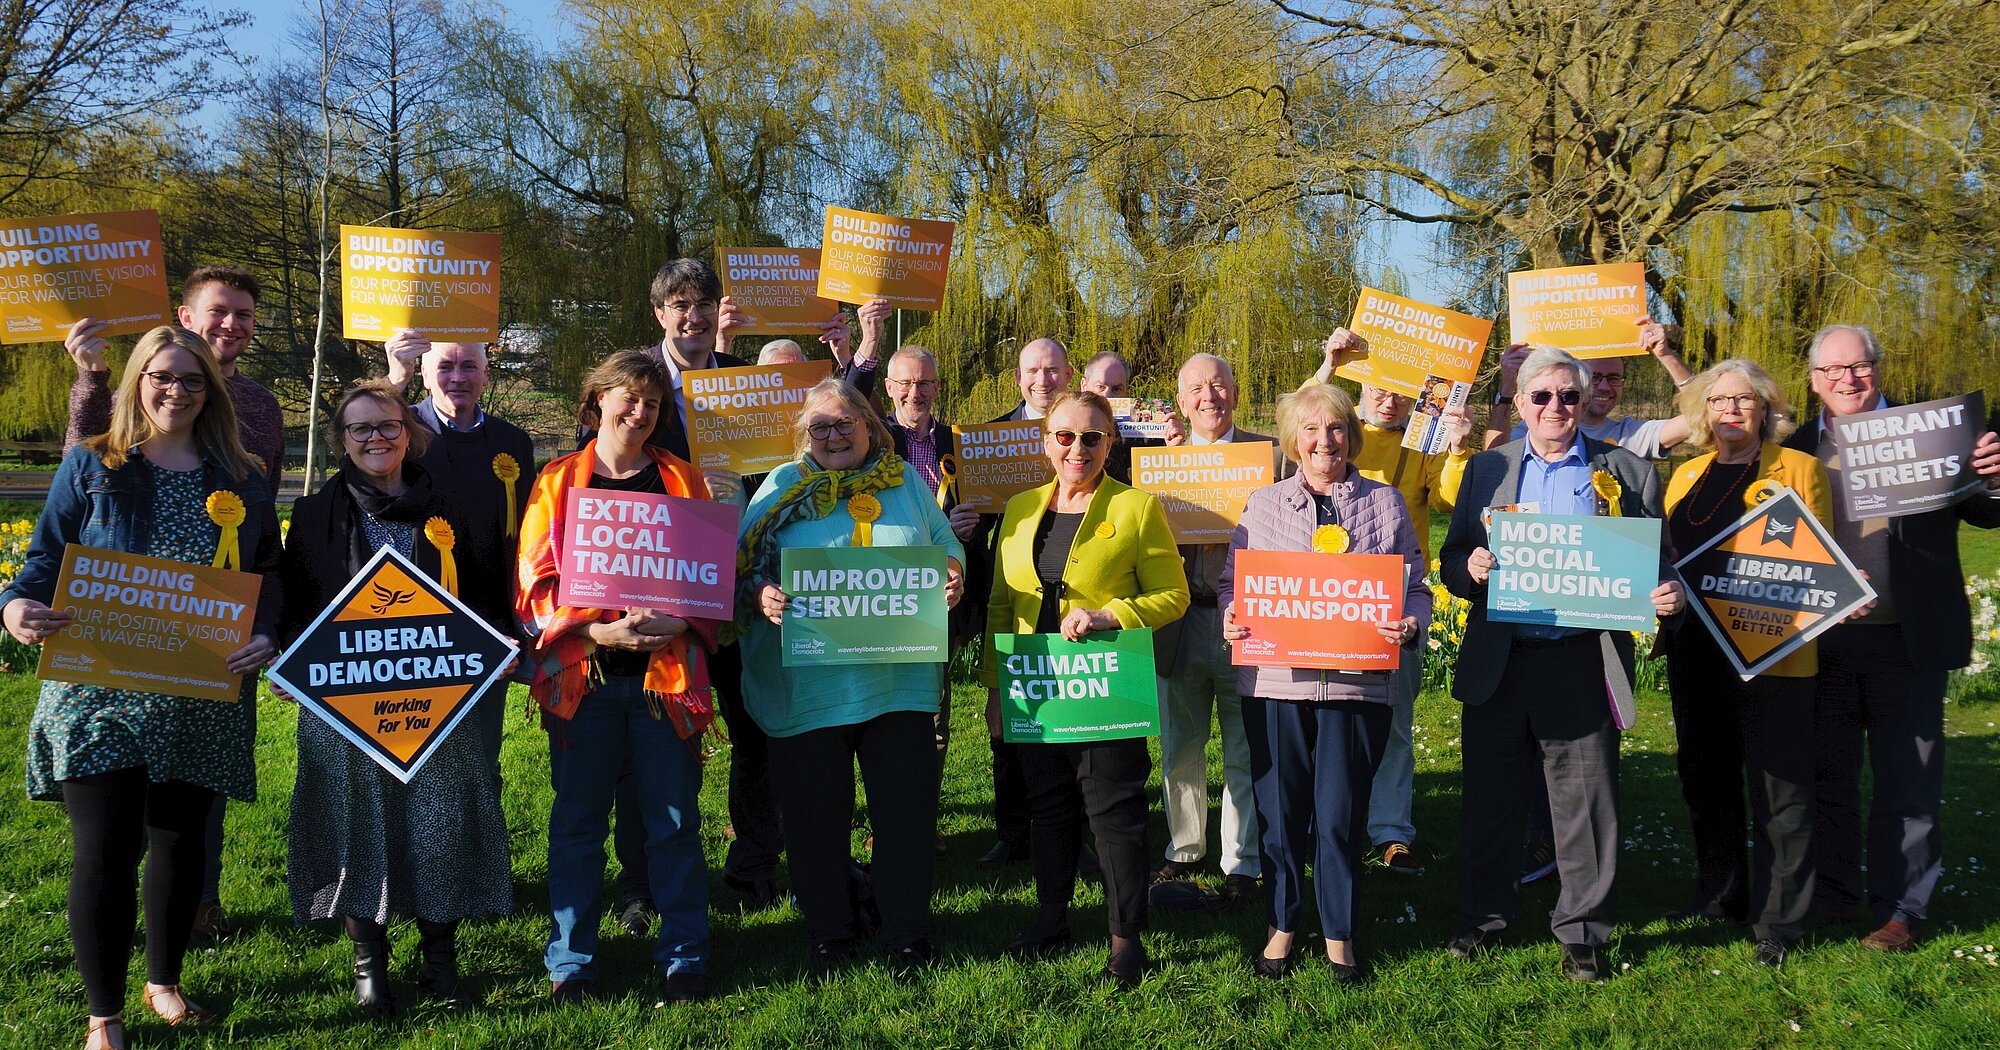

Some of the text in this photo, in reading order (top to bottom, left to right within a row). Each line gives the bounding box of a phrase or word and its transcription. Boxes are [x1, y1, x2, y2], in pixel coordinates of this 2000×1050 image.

[0, 224, 100, 246] UILDING
[832, 214, 911, 238] BUILDING
[350, 235, 445, 256] BUILDING
[831, 231, 944, 256] OPPORTUNITY
[350, 254, 491, 275] OPPORTUNITY
[728, 254, 800, 266] BUILDING
[828, 259, 908, 280] FOR WAVERLEY
[829, 248, 942, 271] OUR POSITIVE VISION
[34, 269, 102, 287] POSITIVE
[106, 264, 156, 280] VISION
[729, 268, 820, 280] OPPORTUNIT
[1516, 273, 1598, 292] BUILDING
[0, 284, 113, 304] FOR WAVERLEY
[351, 277, 491, 294] OUR POSITIVE VISION
[731, 286, 817, 296] OUR POSITIVE VIS
[1519, 285, 1638, 307] OPPORTUNITY
[351, 291, 449, 308] FOR WAVERLEY
[732, 297, 806, 306] FOR WAVERLEY
[1366, 296, 1446, 329] BUILDING
[1546, 307, 1597, 320] POSITIVE
[1600, 304, 1640, 316] VISION
[1362, 311, 1478, 354] OPPORTUNITY
[1544, 318, 1604, 332] WAVERLEY
[1357, 329, 1473, 370] OUR POSITIVE VISION
[1359, 342, 1436, 371] OR WAVERLEY
[692, 372, 784, 394] BUILDING
[694, 388, 814, 411] OPPORTUNIT
[696, 418, 725, 429] OUR
[728, 412, 787, 427] POSITIVE
[1407, 415, 1424, 447] FOCUS
[1840, 404, 1965, 443] VIBRANT
[697, 425, 792, 443] FOR WAVERLEY
[961, 426, 1040, 445] BUILDING
[1432, 427, 1446, 454] BUILDING
[962, 442, 1045, 459] OPPORTU
[1140, 452, 1224, 468] BUILDING
[1846, 438, 1917, 467] HIGH
[963, 464, 988, 475] OUR
[992, 460, 1040, 473] POSITIVE
[1140, 466, 1265, 484] OPPORTUNITY
[1850, 455, 1961, 491] STREETS
[965, 472, 1047, 486] FOR WAVERLEY
[1171, 488, 1224, 500] POSITIVE
[1226, 487, 1258, 498] VISIO
[577, 498, 672, 526] EXTRA
[1168, 501, 1229, 512] WAVERLEY
[1856, 503, 1887, 511] Democrats
[575, 524, 671, 553] LOCAL
[1501, 521, 1583, 546] MORE
[572, 550, 718, 585] TRAINING
[1500, 546, 1600, 572] SOCIAL
[73, 556, 195, 592] BUILDING
[792, 568, 940, 592] IMPROVED
[1726, 557, 1817, 585] LIBERAL
[570, 582, 591, 591] Liberal
[570, 589, 606, 598] Democrats
[1244, 575, 1390, 600] NEW LOCAL
[1499, 570, 1631, 599] HOUSING
[1701, 575, 1837, 608] DEMOCRATS
[69, 579, 246, 621] OPPORTUNITY
[792, 594, 918, 618] SERVICES
[1244, 598, 1392, 622] TRANSPORT
[63, 605, 242, 644] OUR POSITIVE VISION
[1728, 606, 1794, 625] DEMAND
[59, 624, 188, 652] FOR WAVERLEY
[339, 625, 453, 654] LIBERAL
[1732, 620, 1784, 637] BETTER
[52, 654, 78, 664] Liberal
[838, 645, 938, 654] waverleylibdems.org.uk/opportunity
[1242, 648, 1275, 656] Democrats
[1288, 650, 1390, 660] waverleylibdems.org.uk/opportunity
[51, 662, 93, 672] Democrats
[309, 653, 484, 686] DEMOCRATS
[1007, 652, 1119, 675] CLIMATE
[1009, 677, 1109, 700] ACTION
[373, 698, 431, 715] Working
[377, 716, 430, 734] For You
[1053, 721, 1150, 734] waverleylibdems.org.uk/opportunity
